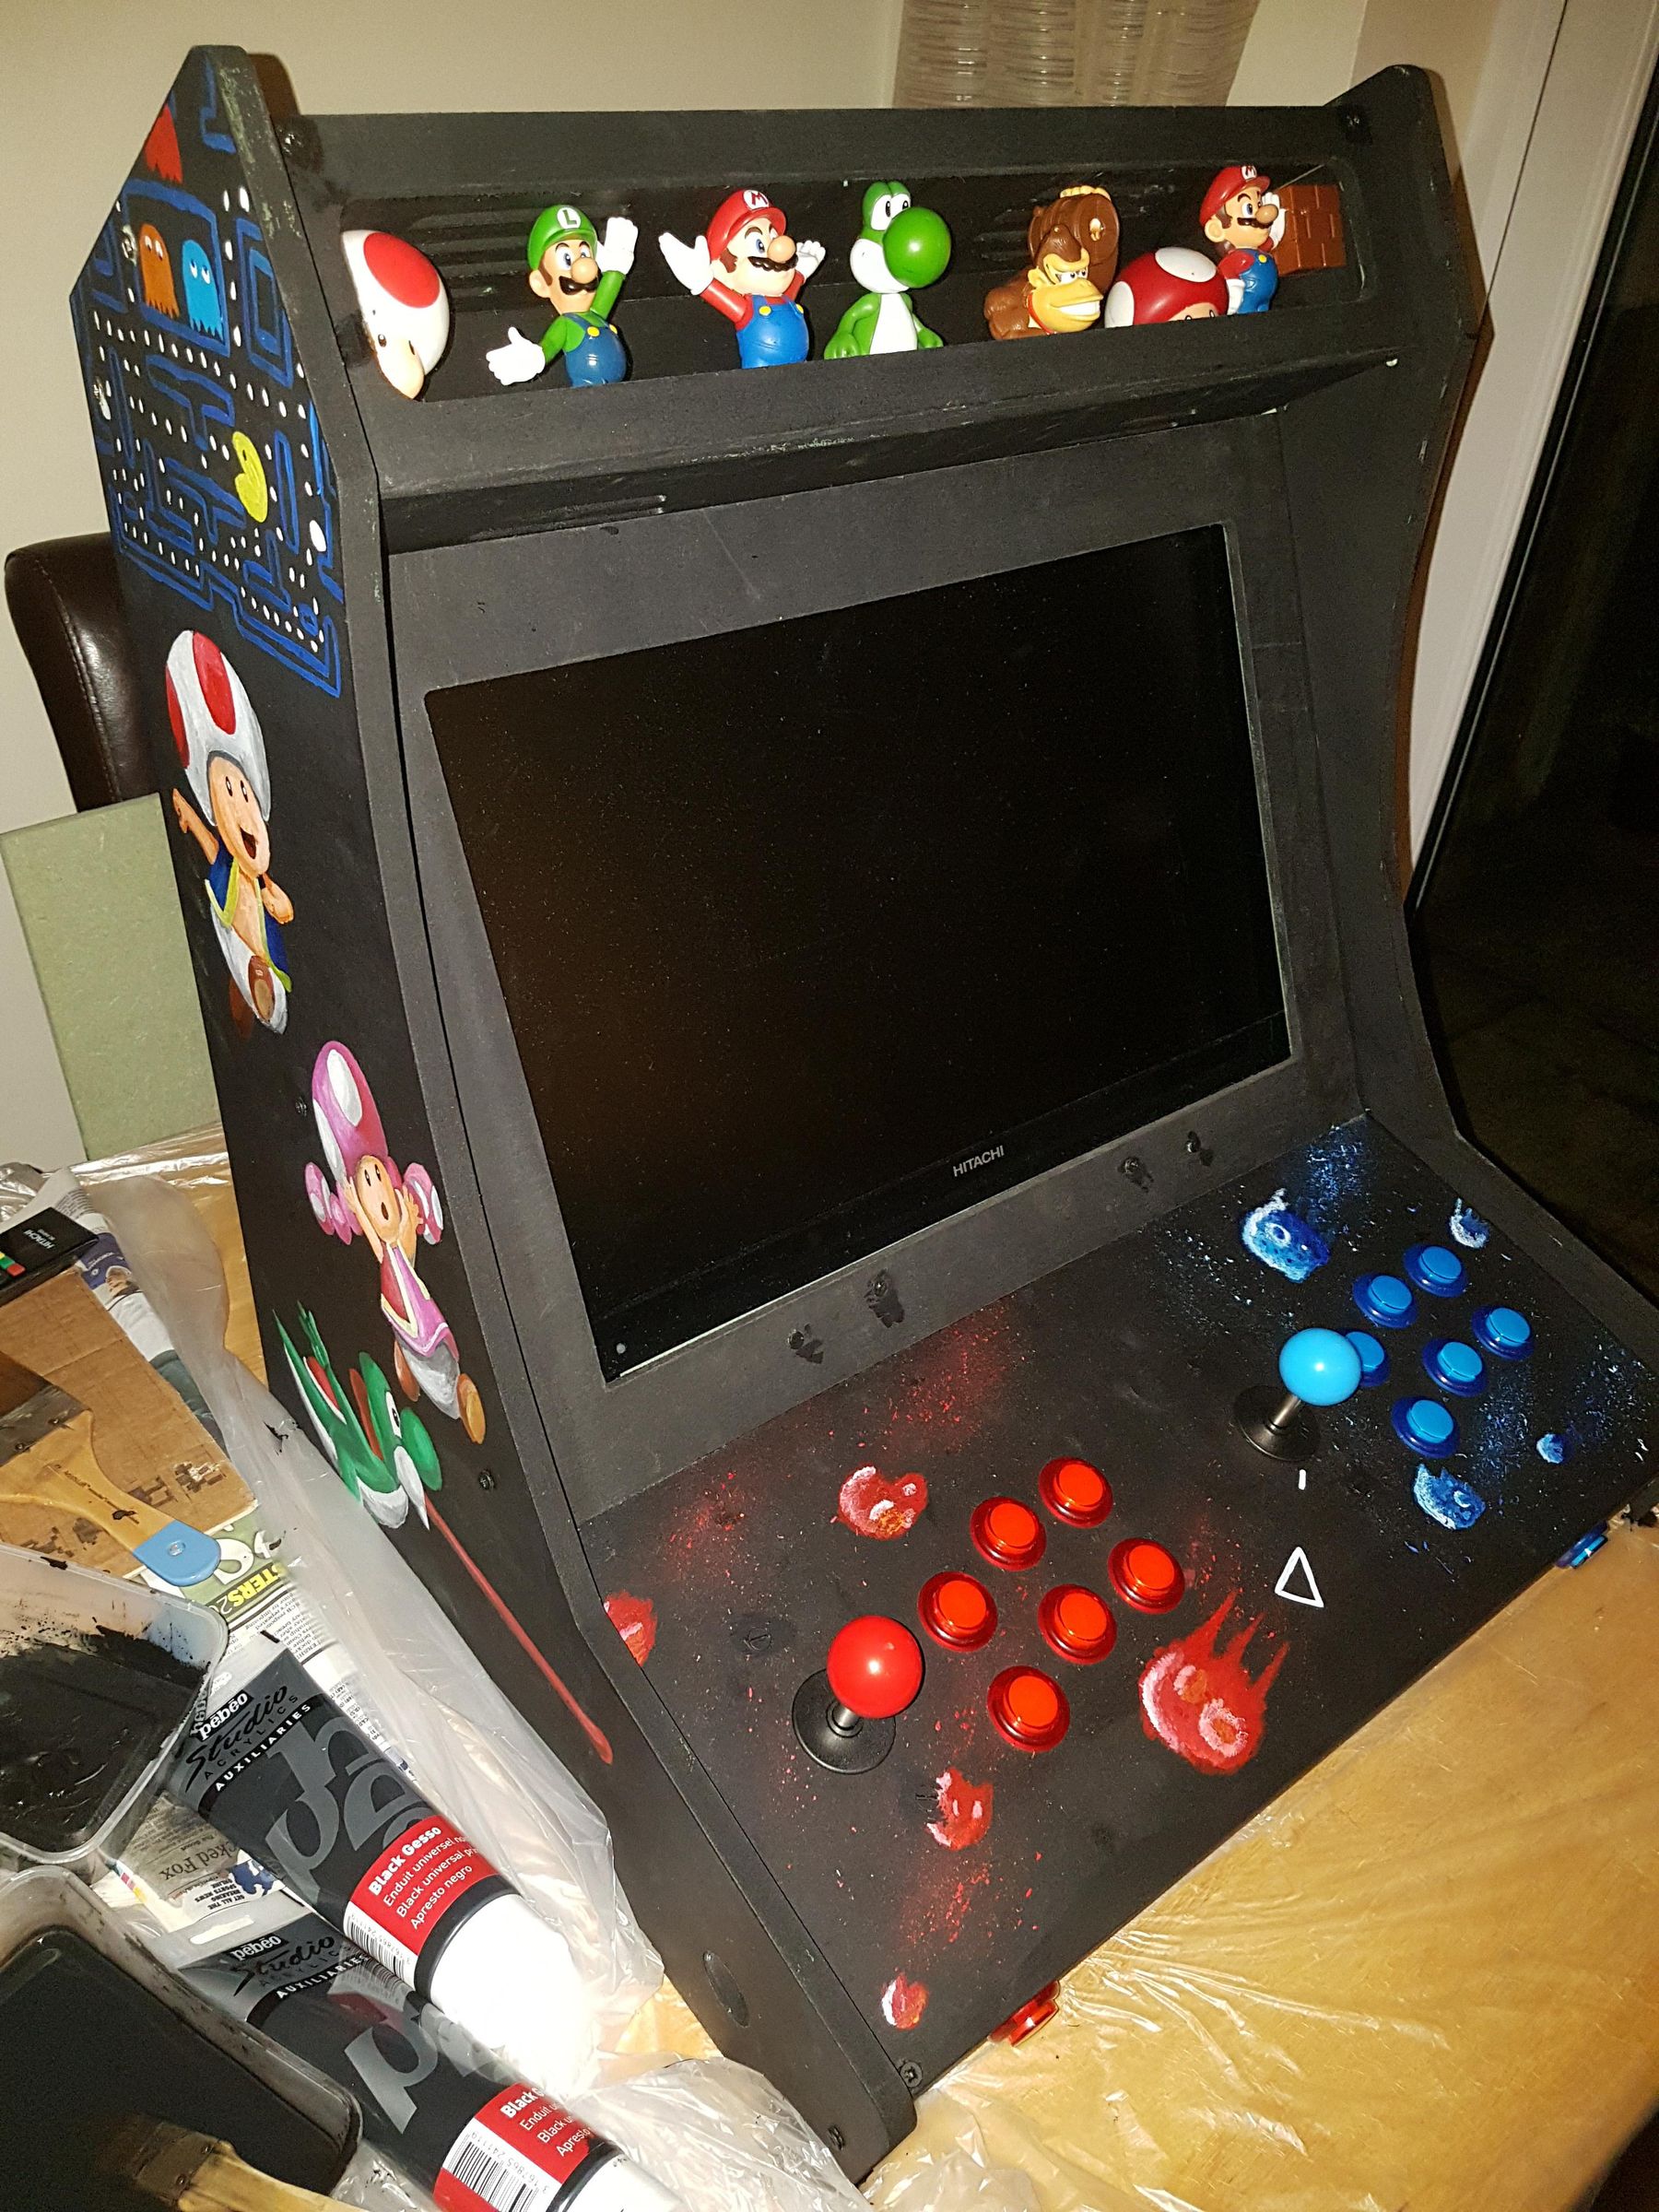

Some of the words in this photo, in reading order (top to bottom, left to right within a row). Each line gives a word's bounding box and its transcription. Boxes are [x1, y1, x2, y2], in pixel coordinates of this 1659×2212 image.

[751, 192, 769, 206] M
[562, 209, 577, 225] L
[952, 1145, 1005, 1177] HITACHI
[24, 1229, 55, 1249] HITACHI
[185, 1686, 287, 1793] Studio
[205, 1695, 299, 1781] ACRYLICS
[215, 1704, 312, 1792] AUXILIARIES
[159, 1857, 198, 1880] Fox
[368, 1854, 406, 1896] Black
[401, 1827, 442, 1856] Gesso
[382, 1872, 415, 1908] Enduit
[412, 1837, 456, 1872] universel
[396, 1884, 425, 1918] Black
[422, 1850, 465, 1887] universal
[410, 1887, 445, 1930] Apresto
[444, 1865, 473, 1888] negro
[276, 1953, 370, 1999] AUXILIARIES
[500, 2091, 534, 2119] Black
[519, 2105, 552, 2131] Enduit
[536, 2120, 566, 2144] Black
[556, 2127, 591, 2157] Apresto
